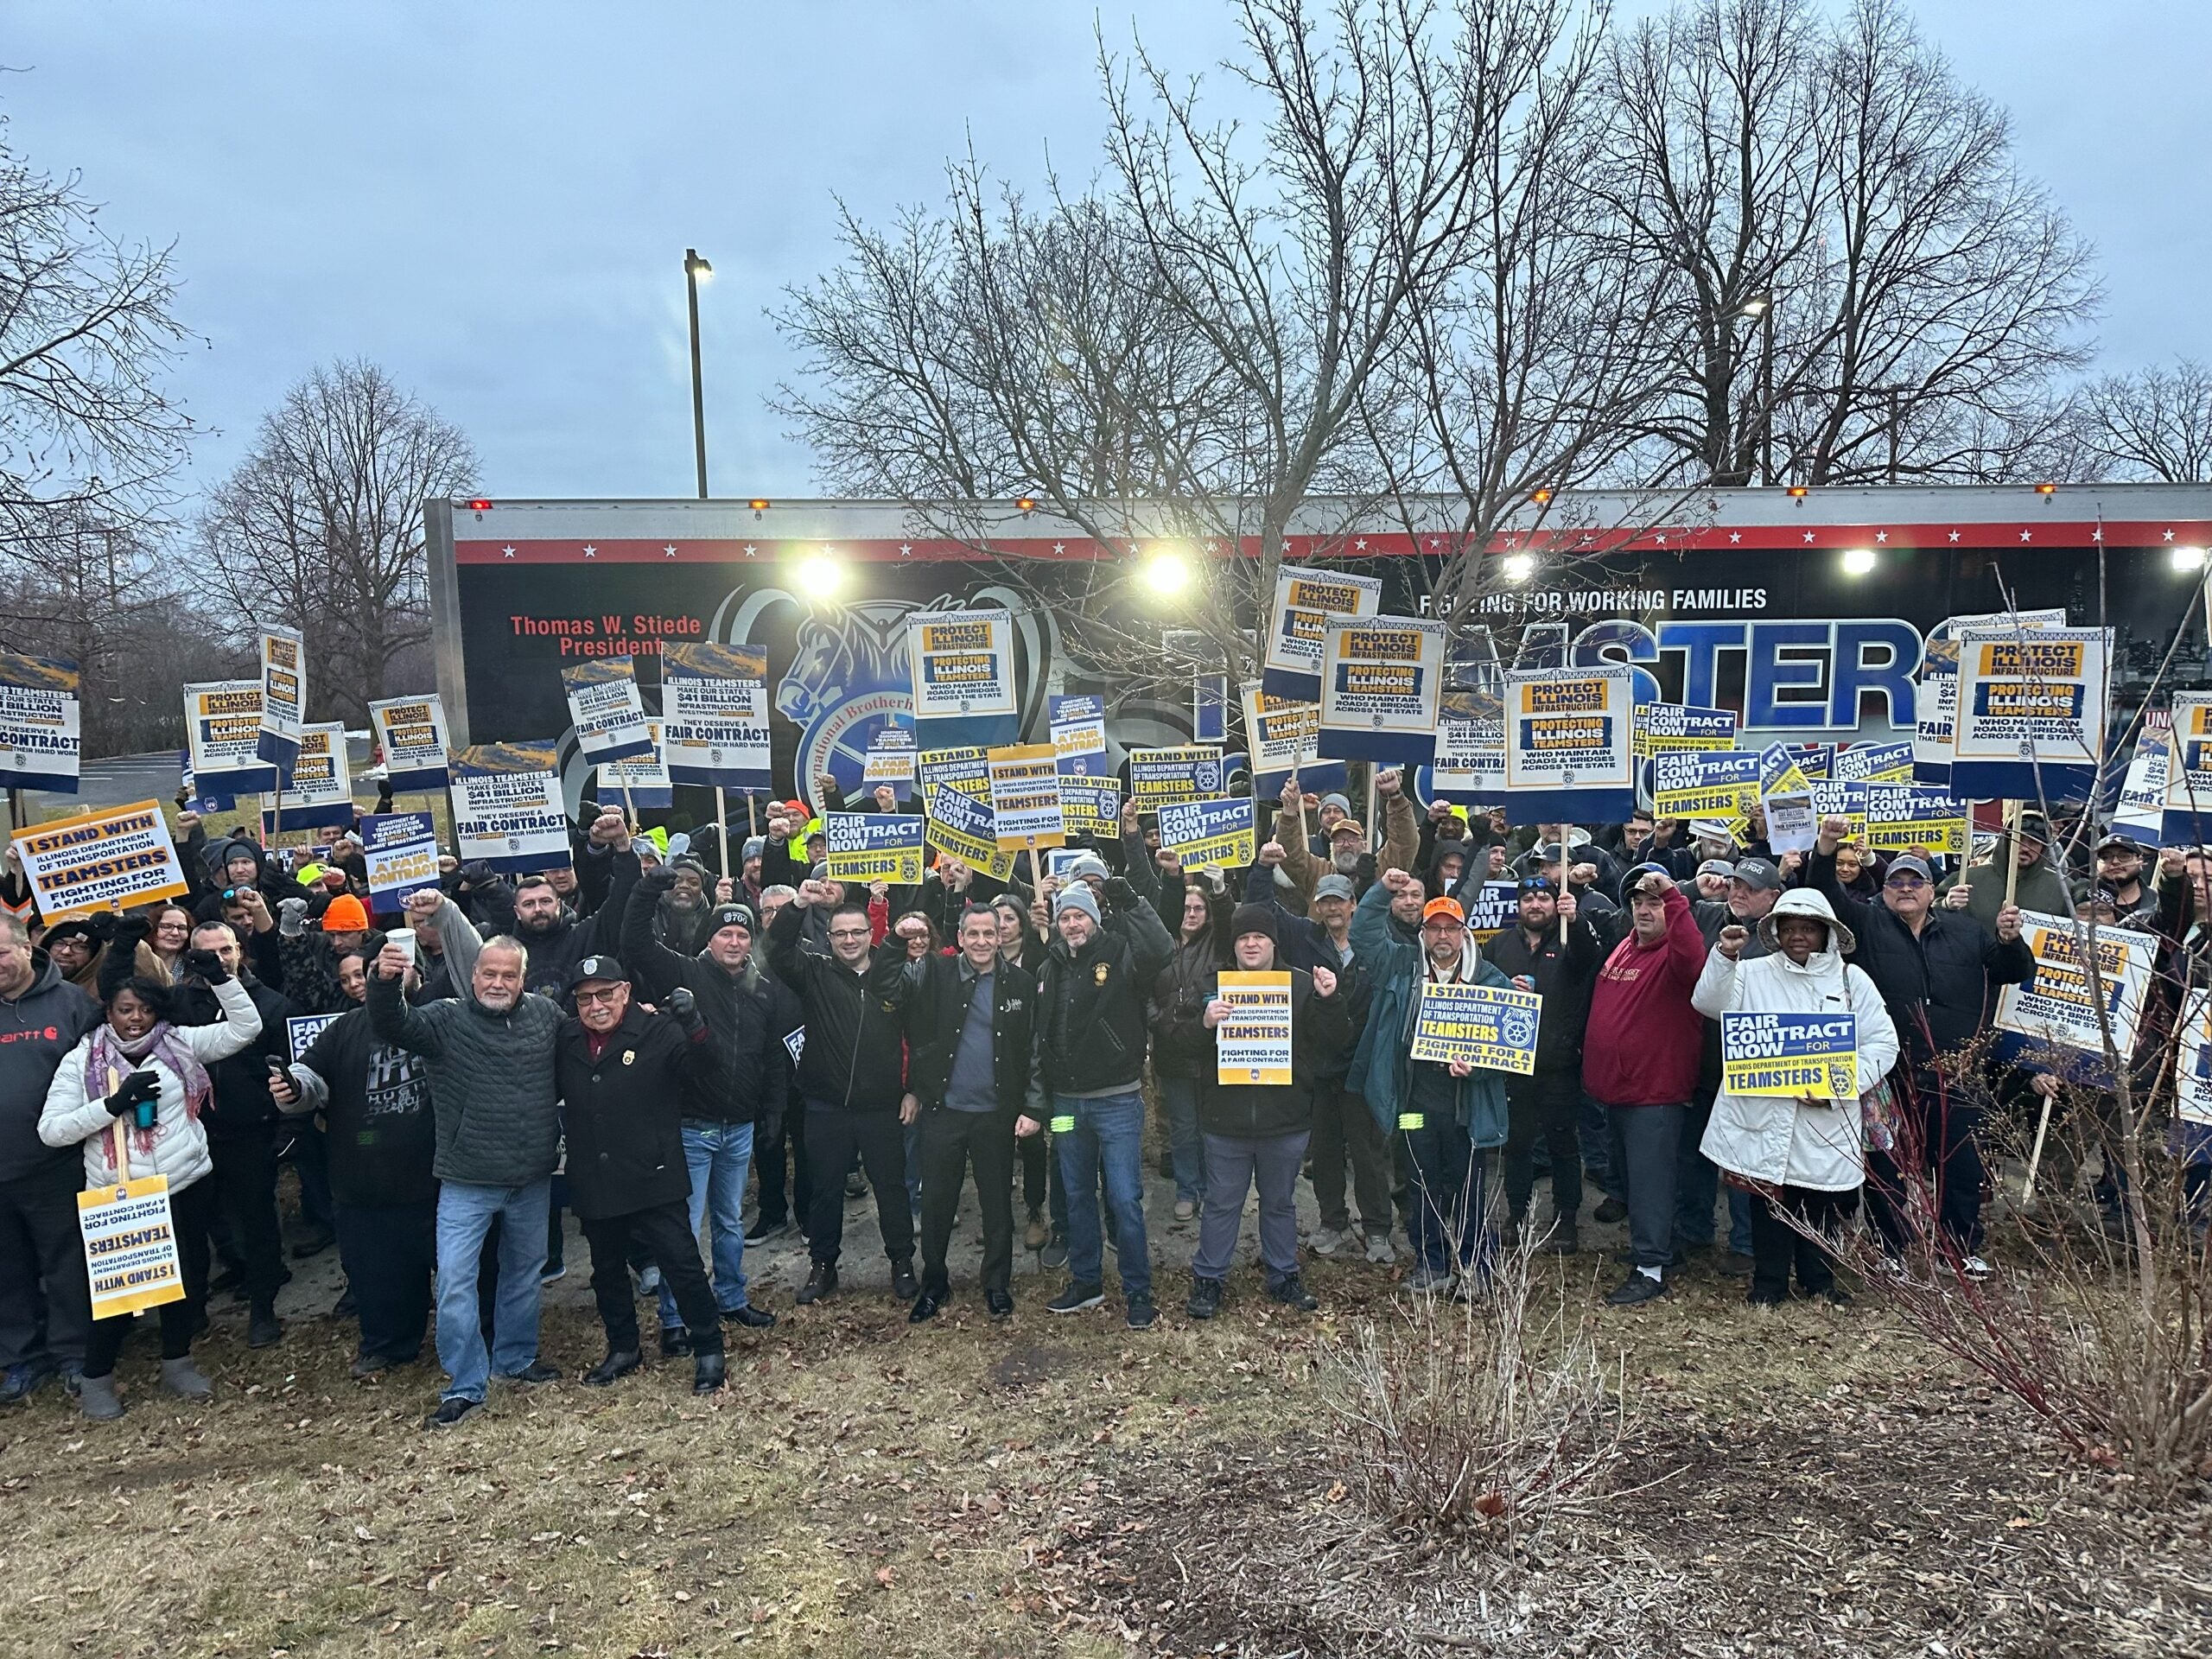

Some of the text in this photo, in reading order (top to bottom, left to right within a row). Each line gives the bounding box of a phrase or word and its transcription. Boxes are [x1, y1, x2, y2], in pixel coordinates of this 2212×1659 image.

[1523, 592, 1561, 612] FOR
[1569, 590, 1664, 612] WORKING
[1673, 588, 1766, 609] FAMILIES
[511, 615, 701, 635] Thomas W. Stiede
[931, 625, 987, 635] PROTECT
[932, 634, 988, 644] ILLINOIS
[1351, 632, 1417, 644] PROTECT
[561, 638, 663, 656] President
[932, 642, 988, 651] INFRASTRUCTURE
[1350, 641, 1417, 652] ILLINOIS
[933, 656, 990, 665] PROTECTING
[1350, 652, 1415, 660] INFRASTRUCTURE
[934, 664, 991, 674] ILLINOIS
[1348, 666, 1415, 677] PROTECTING
[668, 677, 761, 688] ILLINOIS TEAMSTERS
[934, 672, 991, 682] TEAMSTERS
[1347, 676, 1414, 686] ILLINOIS
[11, 687, 73, 699] TEAMSTERS
[1347, 684, 1414, 695] TEAMSTERS
[1532, 683, 1602, 695] PROTECT
[702, 695, 751, 703] BILLION
[1532, 693, 1603, 704] ILLINOIS
[7, 702, 61, 713] BILLION
[388, 706, 427, 715] PROTECT
[1533, 702, 1602, 712] INFRASTRUCTURE
[1651, 707, 1685, 716] FAIR
[391, 712, 428, 721] ILLINOIS
[575, 711, 644, 734] FAIR CONTRACT
[1649, 716, 1733, 728] CONTRACT
[394, 727, 431, 735] PROTECTING
[1532, 719, 1604, 730] PROTECTING
[1649, 727, 1687, 736] NOW
[1918, 721, 1953, 736] FAIR
[395, 733, 433, 741] ILLINOIS
[665, 726, 769, 741] FAIR CONTRACT
[1532, 728, 1604, 740] ILLINOIS
[1, 733, 79, 749] CONTRACT
[1533, 739, 1604, 747] TEAMSTERS
[813, 696, 912, 810] International Brotherh
[1140, 753, 1182, 761] STAND
[1185, 751, 1218, 760] WITH
[1657, 753, 1700, 768] FAIR
[993, 765, 1054, 779] I STAND WITH
[1657, 758, 1758, 780] CONTRACT
[455, 771, 553, 785] ILLINOIS TEAMSTERS
[1657, 776, 1703, 791] NOW
[468, 786, 544, 799] $41 BILLION
[1134, 780, 1195, 793] TEAMSTERS
[468, 794, 546, 804] INFRASTRUCTURE
[1870, 788, 1910, 800] FAIR
[995, 796, 1058, 810] TEAMSTERS
[1657, 795, 1732, 815] TEAMSTERS
[1162, 804, 1202, 823] FAIR
[1162, 804, 1251, 834] CONTRACT
[1869, 810, 1914, 823] NOW
[457, 814, 564, 834] FAIR CONTRACT
[829, 816, 865, 830] FAIR
[998, 817, 1041, 826] FIGHTING
[27, 815, 153, 853] I STAND WITH
[829, 823, 920, 841] CONTRACT
[1164, 822, 1237, 846] NOW FOR
[1868, 830, 1943, 845] TEAMSTERS
[37, 832, 149, 862] ILLINOIS DEPARTMENT
[829, 838, 903, 852] NOW FOR
[928, 827, 988, 862] TEAMSTERS
[56, 840, 155, 868] TRANSPORTATION
[395, 848, 428, 859] DESERVE
[38, 850, 166, 889] TEAMSTERS
[375, 855, 430, 873] A FAIR
[830, 860, 895, 876] TEAMSTERS
[370, 862, 437, 886] CONTRACT
[50, 868, 165, 900] FIGHTING FOR
[64, 894, 93, 906] FAIR
[96, 878, 169, 898] CONTRACT.
[1228, 994, 1287, 1004] STAND WITH
[1427, 987, 1537, 1007] I STAND WITH
[1425, 1001, 1503, 1014] ILLINOIS DEPARTMENT
[1423, 1010, 1495, 1024] OF TRANSPORTATION
[1726, 1014, 1779, 1033] FAIR
[1222, 1027, 1288, 1038] TEAMSTERS
[1421, 1020, 1498, 1042] TEAMSTERS
[1726, 1021, 1853, 1046] CONTRACT
[1418, 1039, 1531, 1061] FIGHTING FOR A
[1727, 1041, 1830, 1059] NOW FOR
[1416, 1047, 1530, 1071] FAIR CONTRACT
[1728, 1062, 1751, 1071] ILLINOIS
[1753, 1060, 1790, 1070] DEPARTMENT
[1802, 1056, 1853, 1065] TRANSPORTATION
[1728, 1067, 1822, 1090] TEAMSTERS
[85, 1206, 166, 1230] FIGHTING FOR
[89, 1226, 170, 1255] TEAMSTERS
[95, 1266, 168, 1292] STAND WITH
